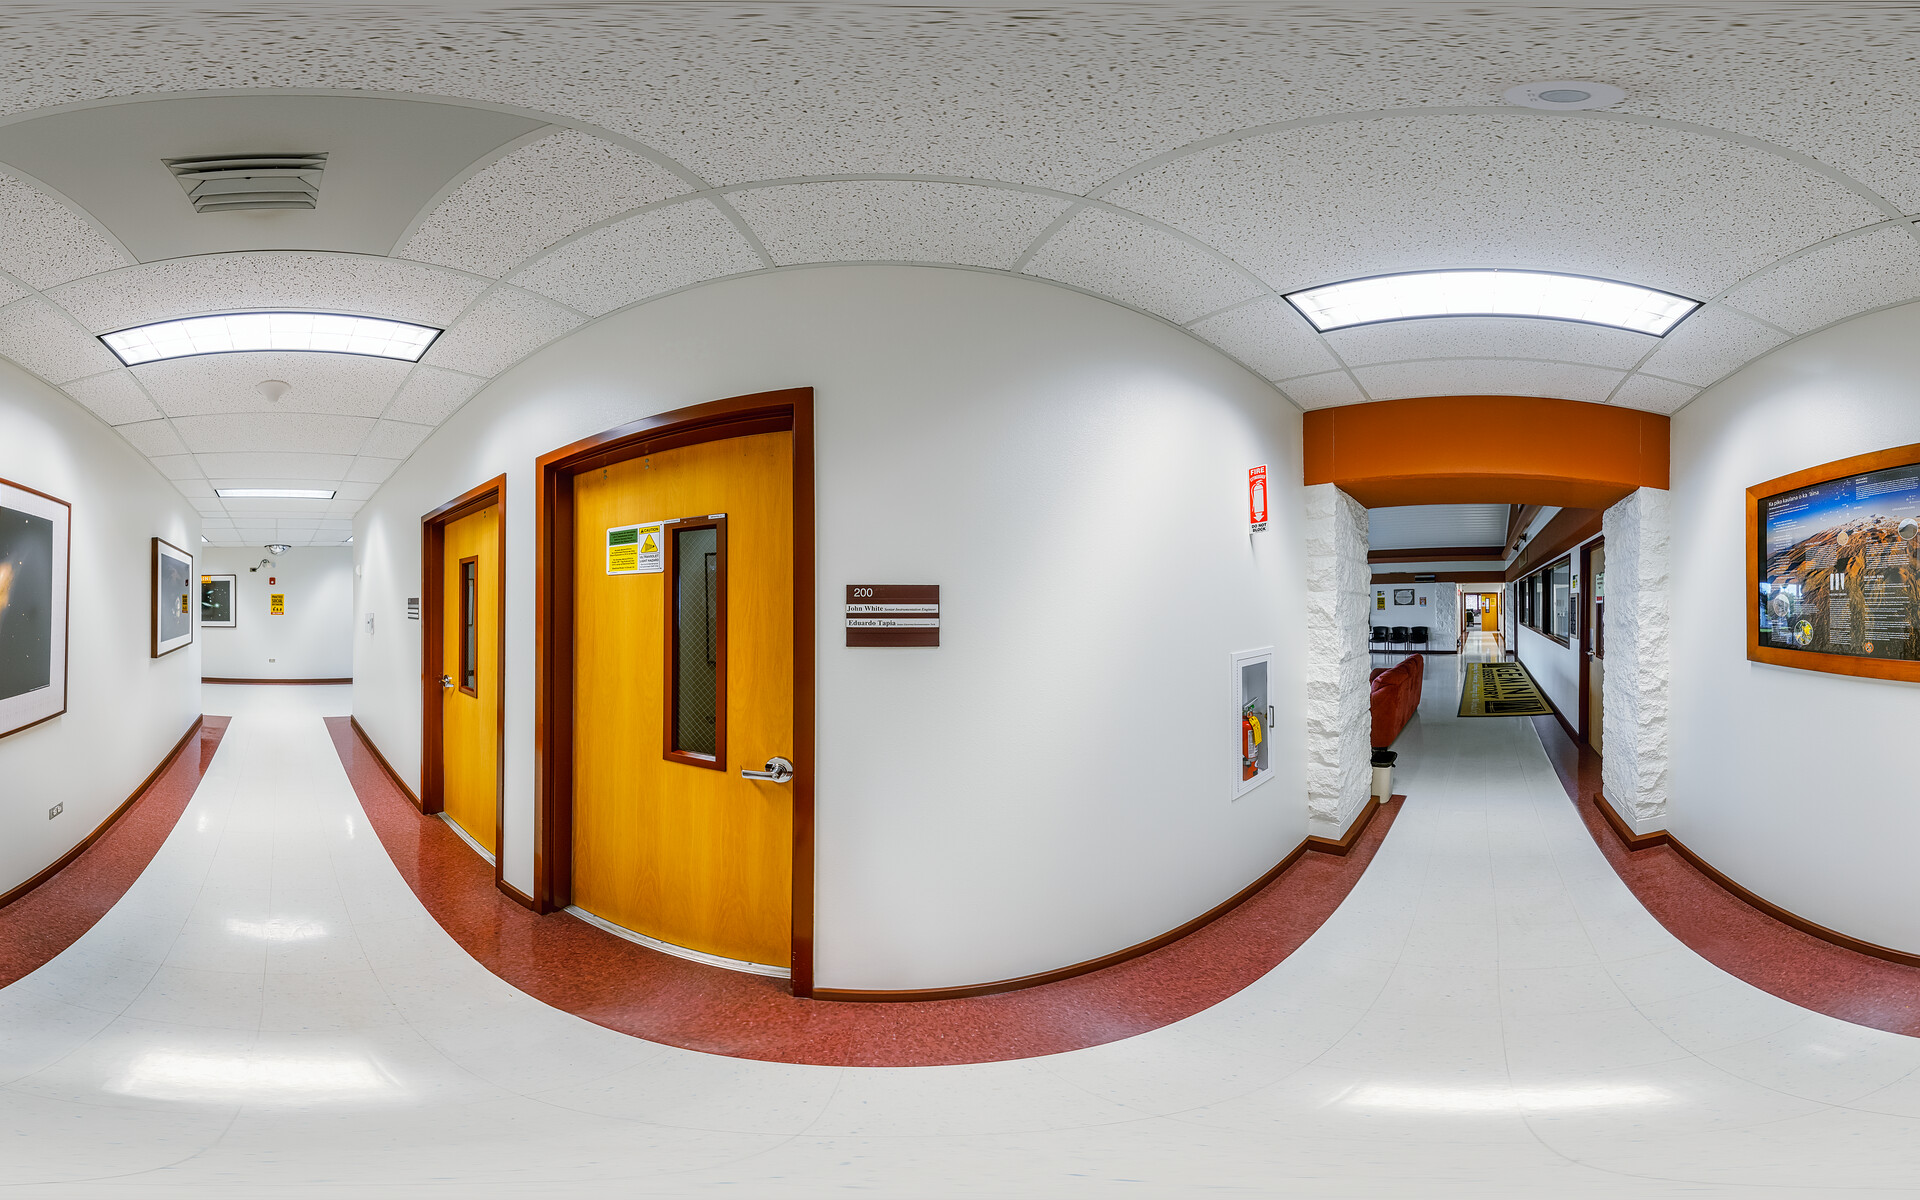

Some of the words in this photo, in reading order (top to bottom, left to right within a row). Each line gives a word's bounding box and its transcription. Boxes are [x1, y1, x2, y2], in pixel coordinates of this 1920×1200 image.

[1250, 467, 1264, 475] FIRE
[853, 587, 873, 598] 200
[877, 619, 896, 627] Tapia
[1482, 669, 1500, 699] OBSERVATORY
[1496, 668, 1537, 699] GEMINI
